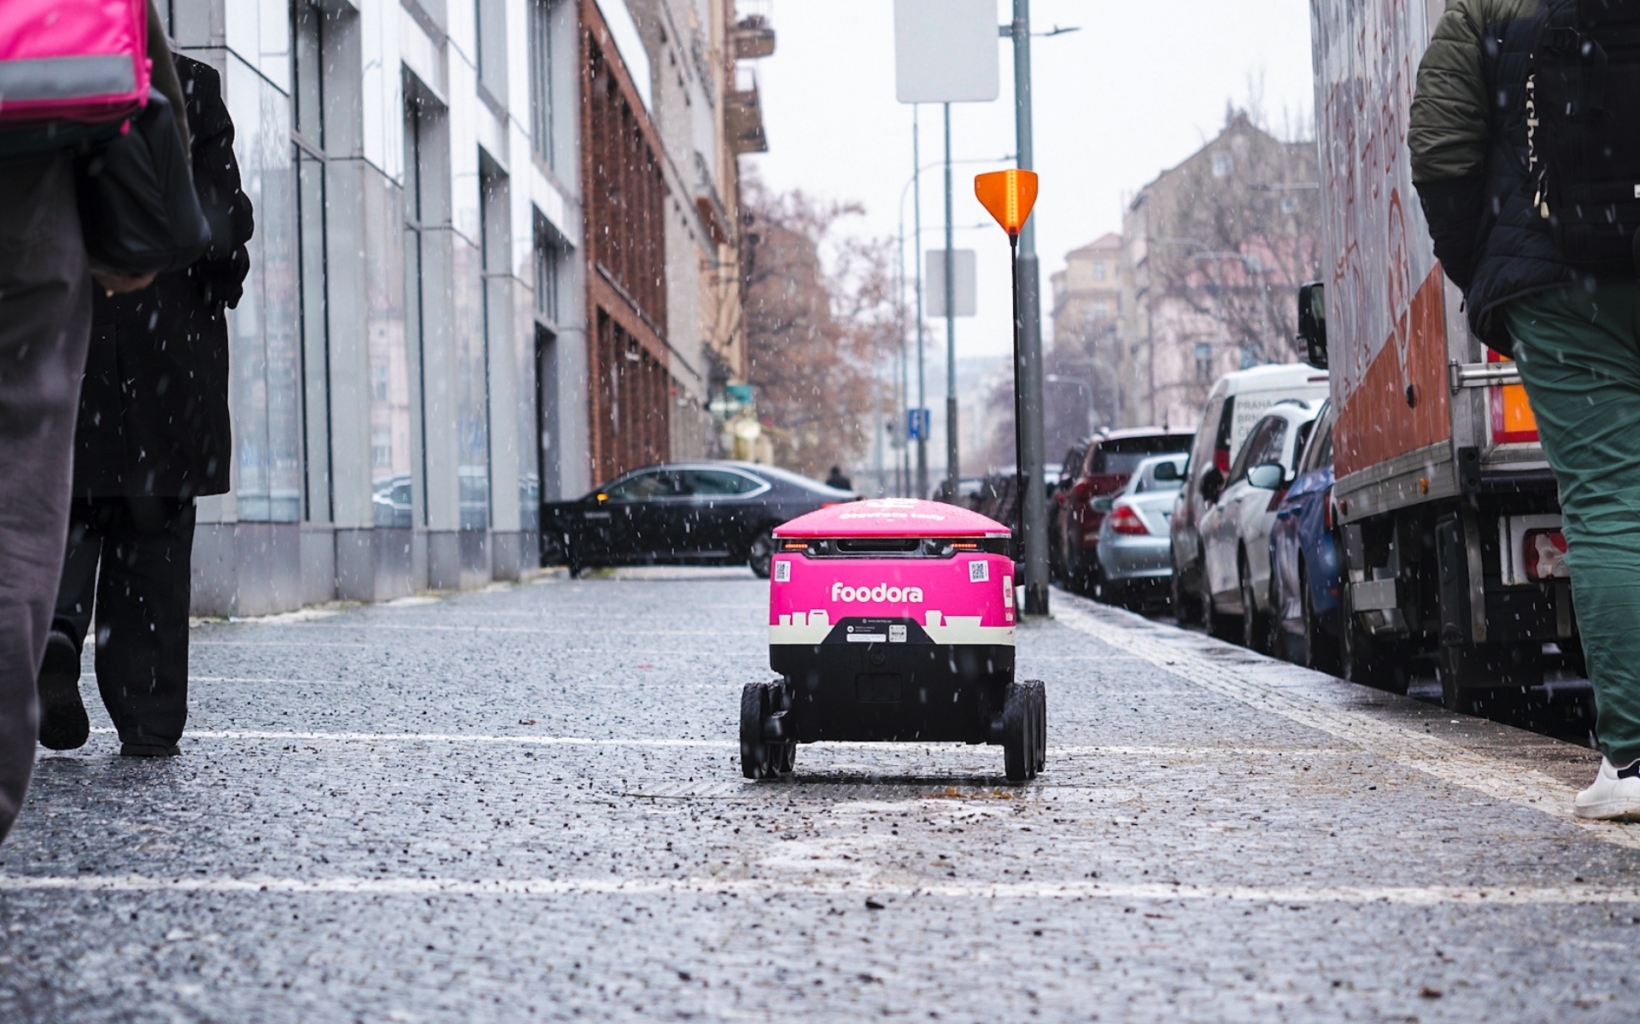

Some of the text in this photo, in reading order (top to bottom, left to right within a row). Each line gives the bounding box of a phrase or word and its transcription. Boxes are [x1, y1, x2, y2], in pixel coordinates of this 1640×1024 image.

[1237, 400, 1272, 410] PRAHA
[1237, 413, 1264, 424] BRN
[831, 581, 923, 602] foodora
